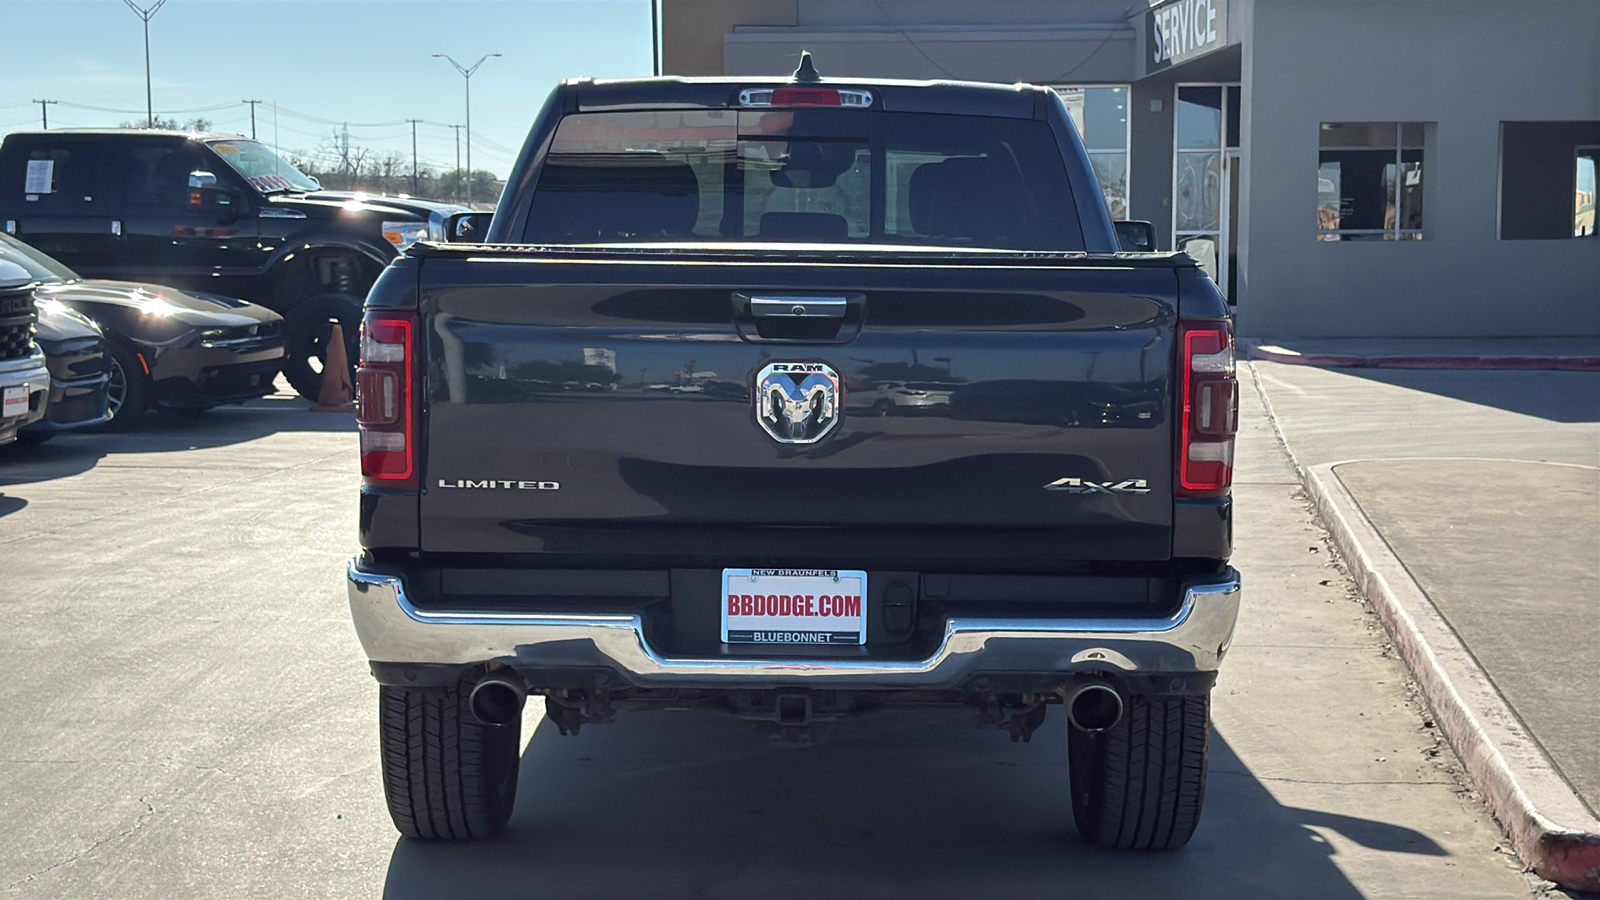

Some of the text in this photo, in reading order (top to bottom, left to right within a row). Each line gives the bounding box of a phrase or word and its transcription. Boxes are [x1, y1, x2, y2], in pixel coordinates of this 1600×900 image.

[1154, 0, 1217, 64] SERVICE
[773, 364, 823, 372] RAM
[439, 479, 560, 490] LIMITED
[728, 594, 862, 617] BBDODGE.COM
[753, 632, 833, 643] BLUEBONNET
